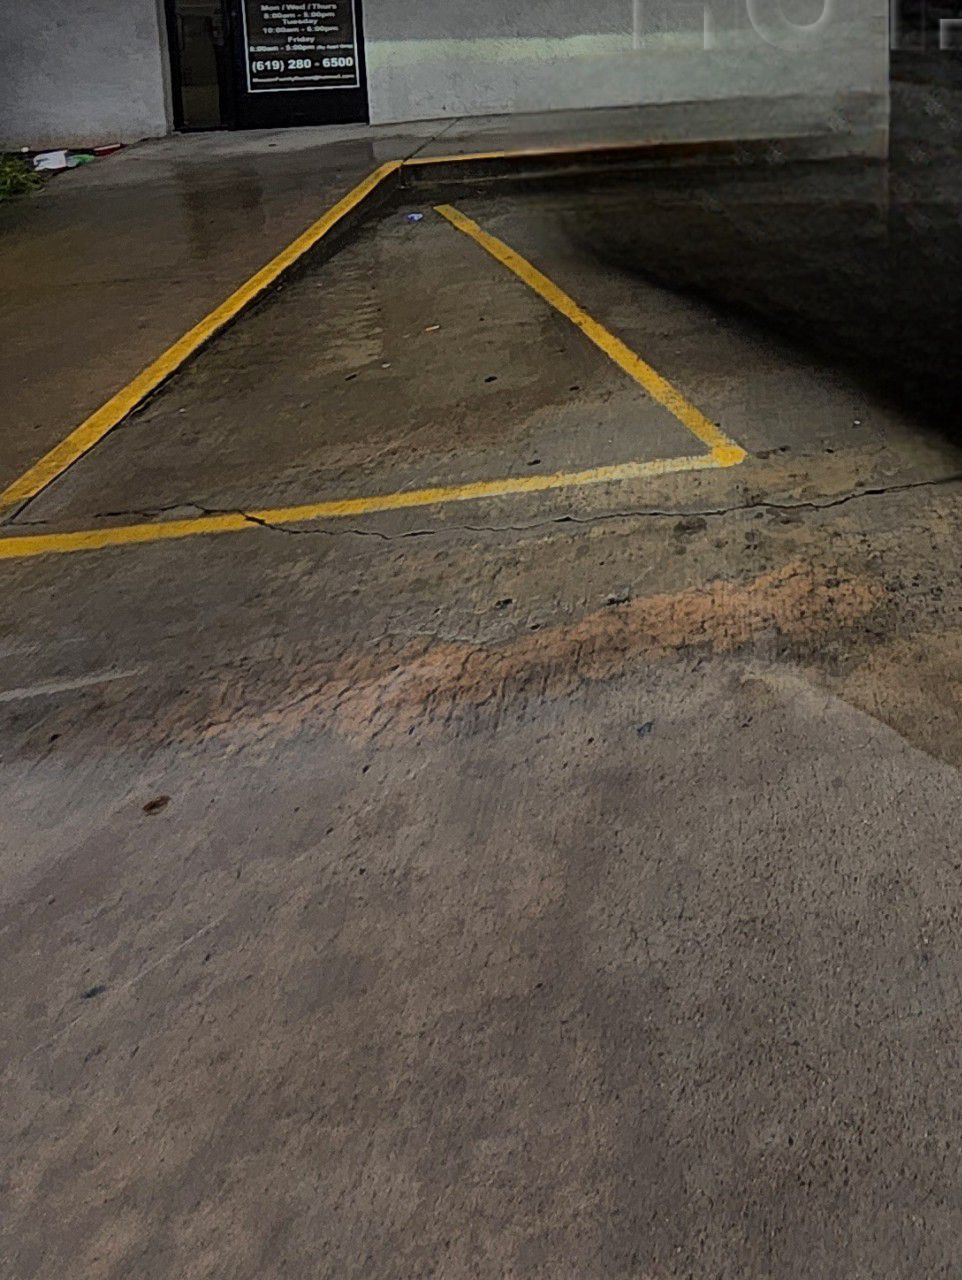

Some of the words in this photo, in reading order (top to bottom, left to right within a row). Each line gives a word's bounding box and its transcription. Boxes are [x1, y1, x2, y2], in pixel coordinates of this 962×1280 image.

[252, 60, 285, 73] (619)
[287, 58, 312, 69] 280
[322, 57, 354, 68] 6500
